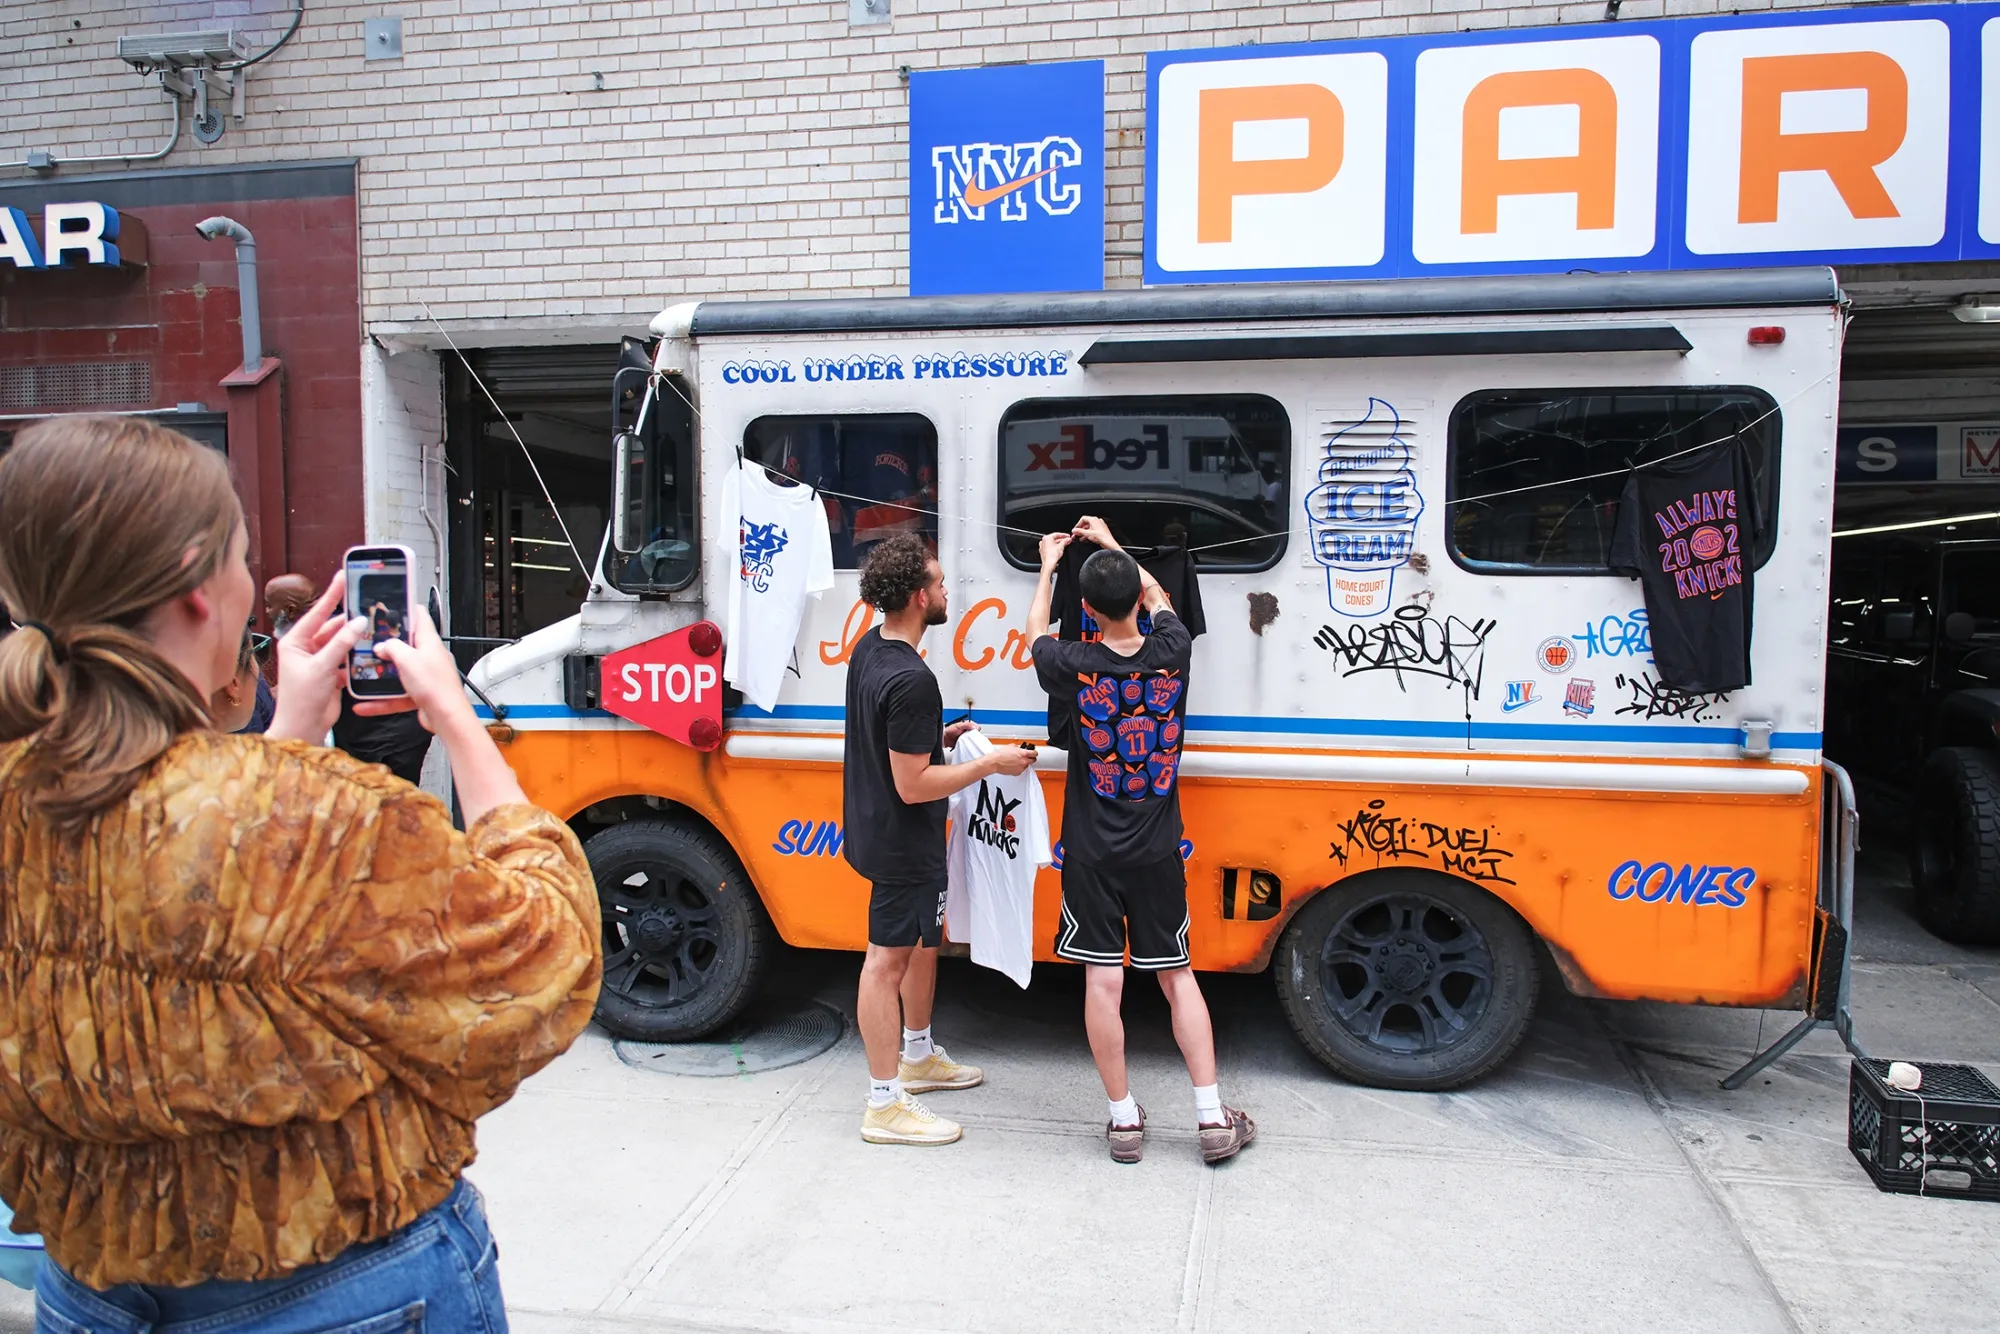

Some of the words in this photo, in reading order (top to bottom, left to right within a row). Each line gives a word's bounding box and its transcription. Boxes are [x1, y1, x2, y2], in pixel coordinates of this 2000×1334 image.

[932, 136, 1082, 224] NYC
[722, 360, 796, 384] COOL
[802, 353, 905, 382] UNDER
[912, 350, 1068, 380] PRESSURE
[1325, 477, 1410, 521] ICE
[1655, 489, 1737, 540] ALWAYS
[1319, 531, 1406, 562] CREAM
[1658, 538, 1691, 573] 20
[1336, 578, 1358, 593] HOME
[1359, 579, 1386, 592] COURT
[1345, 593, 1374, 606] CONES!
[621, 662, 717, 704] STOP
[1080, 679, 1116, 707] HART
[1150, 678, 1181, 694] TOWNS
[1507, 682, 1533, 703] NY
[1098, 696, 1117, 716] 3
[1148, 689, 1171, 707] 32
[1117, 718, 1155, 737] BRUNSON
[1125, 732, 1149, 756] 11
[1095, 774, 1116, 795] 25
[1154, 765, 1174, 790] 8
[975, 778, 1023, 832] NY
[772, 819, 845, 859] SUN
[1607, 860, 1757, 909] CONES
